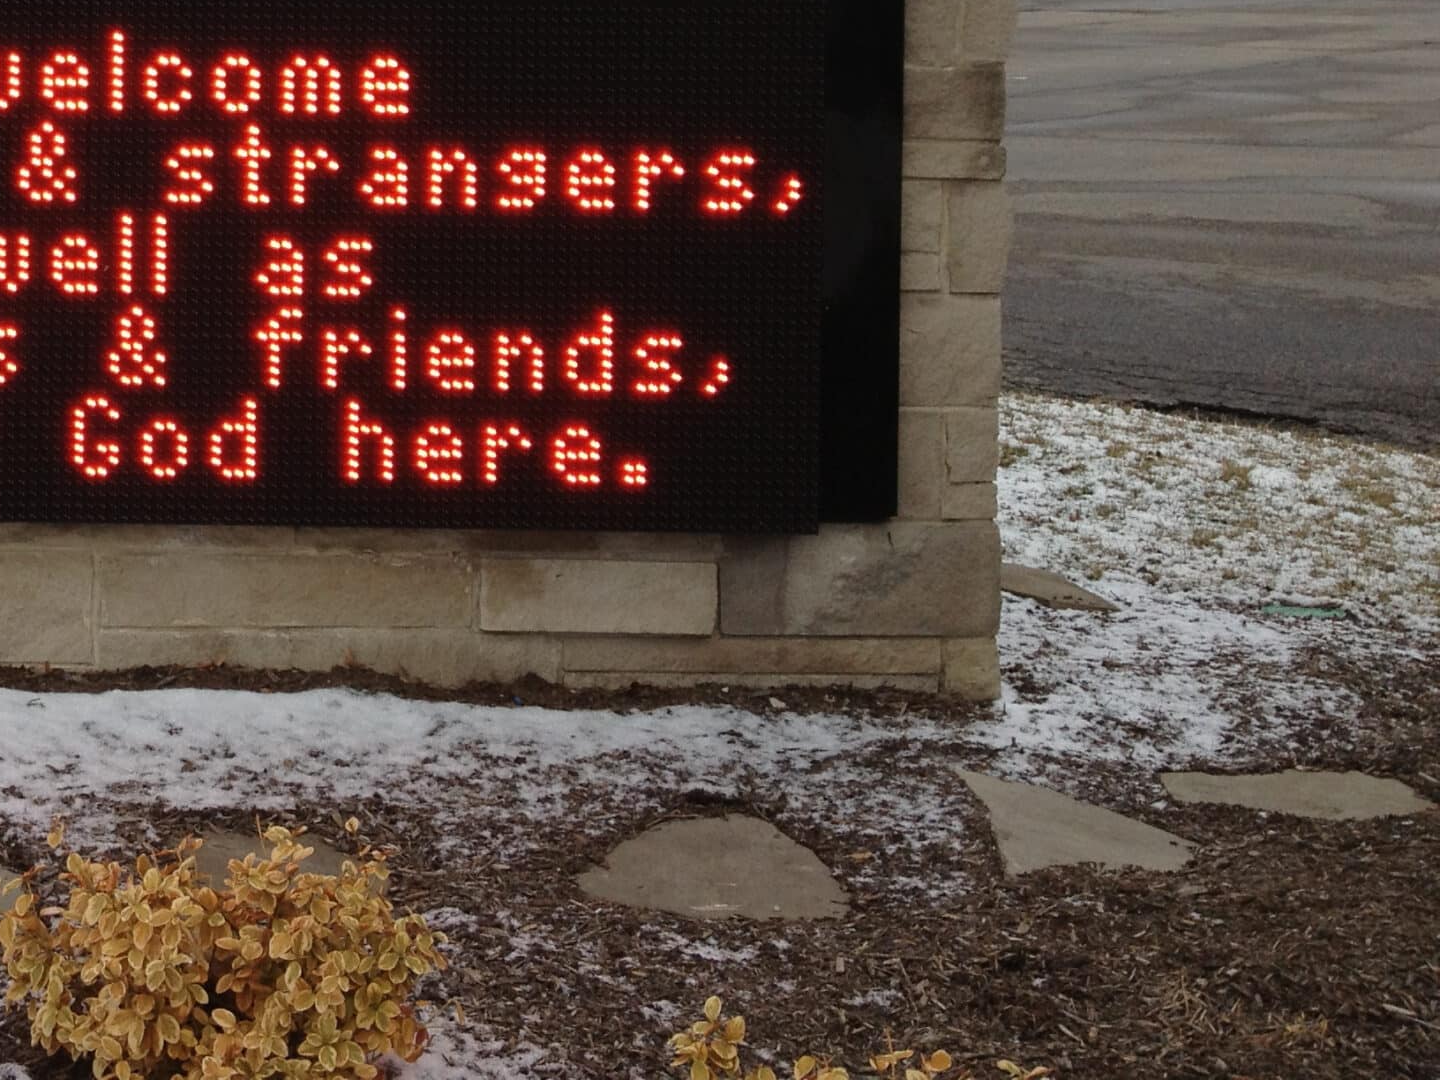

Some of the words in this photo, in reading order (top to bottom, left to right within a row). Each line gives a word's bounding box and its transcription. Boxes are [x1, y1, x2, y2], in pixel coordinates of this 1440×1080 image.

[16, 120, 77, 203] &
[164, 123, 803, 214] strangers,
[255, 236, 374, 297] as
[106, 304, 167, 387] &
[254, 306, 731, 397] friends,
[69, 395, 258, 480] God
[342, 399, 646, 487] here.
